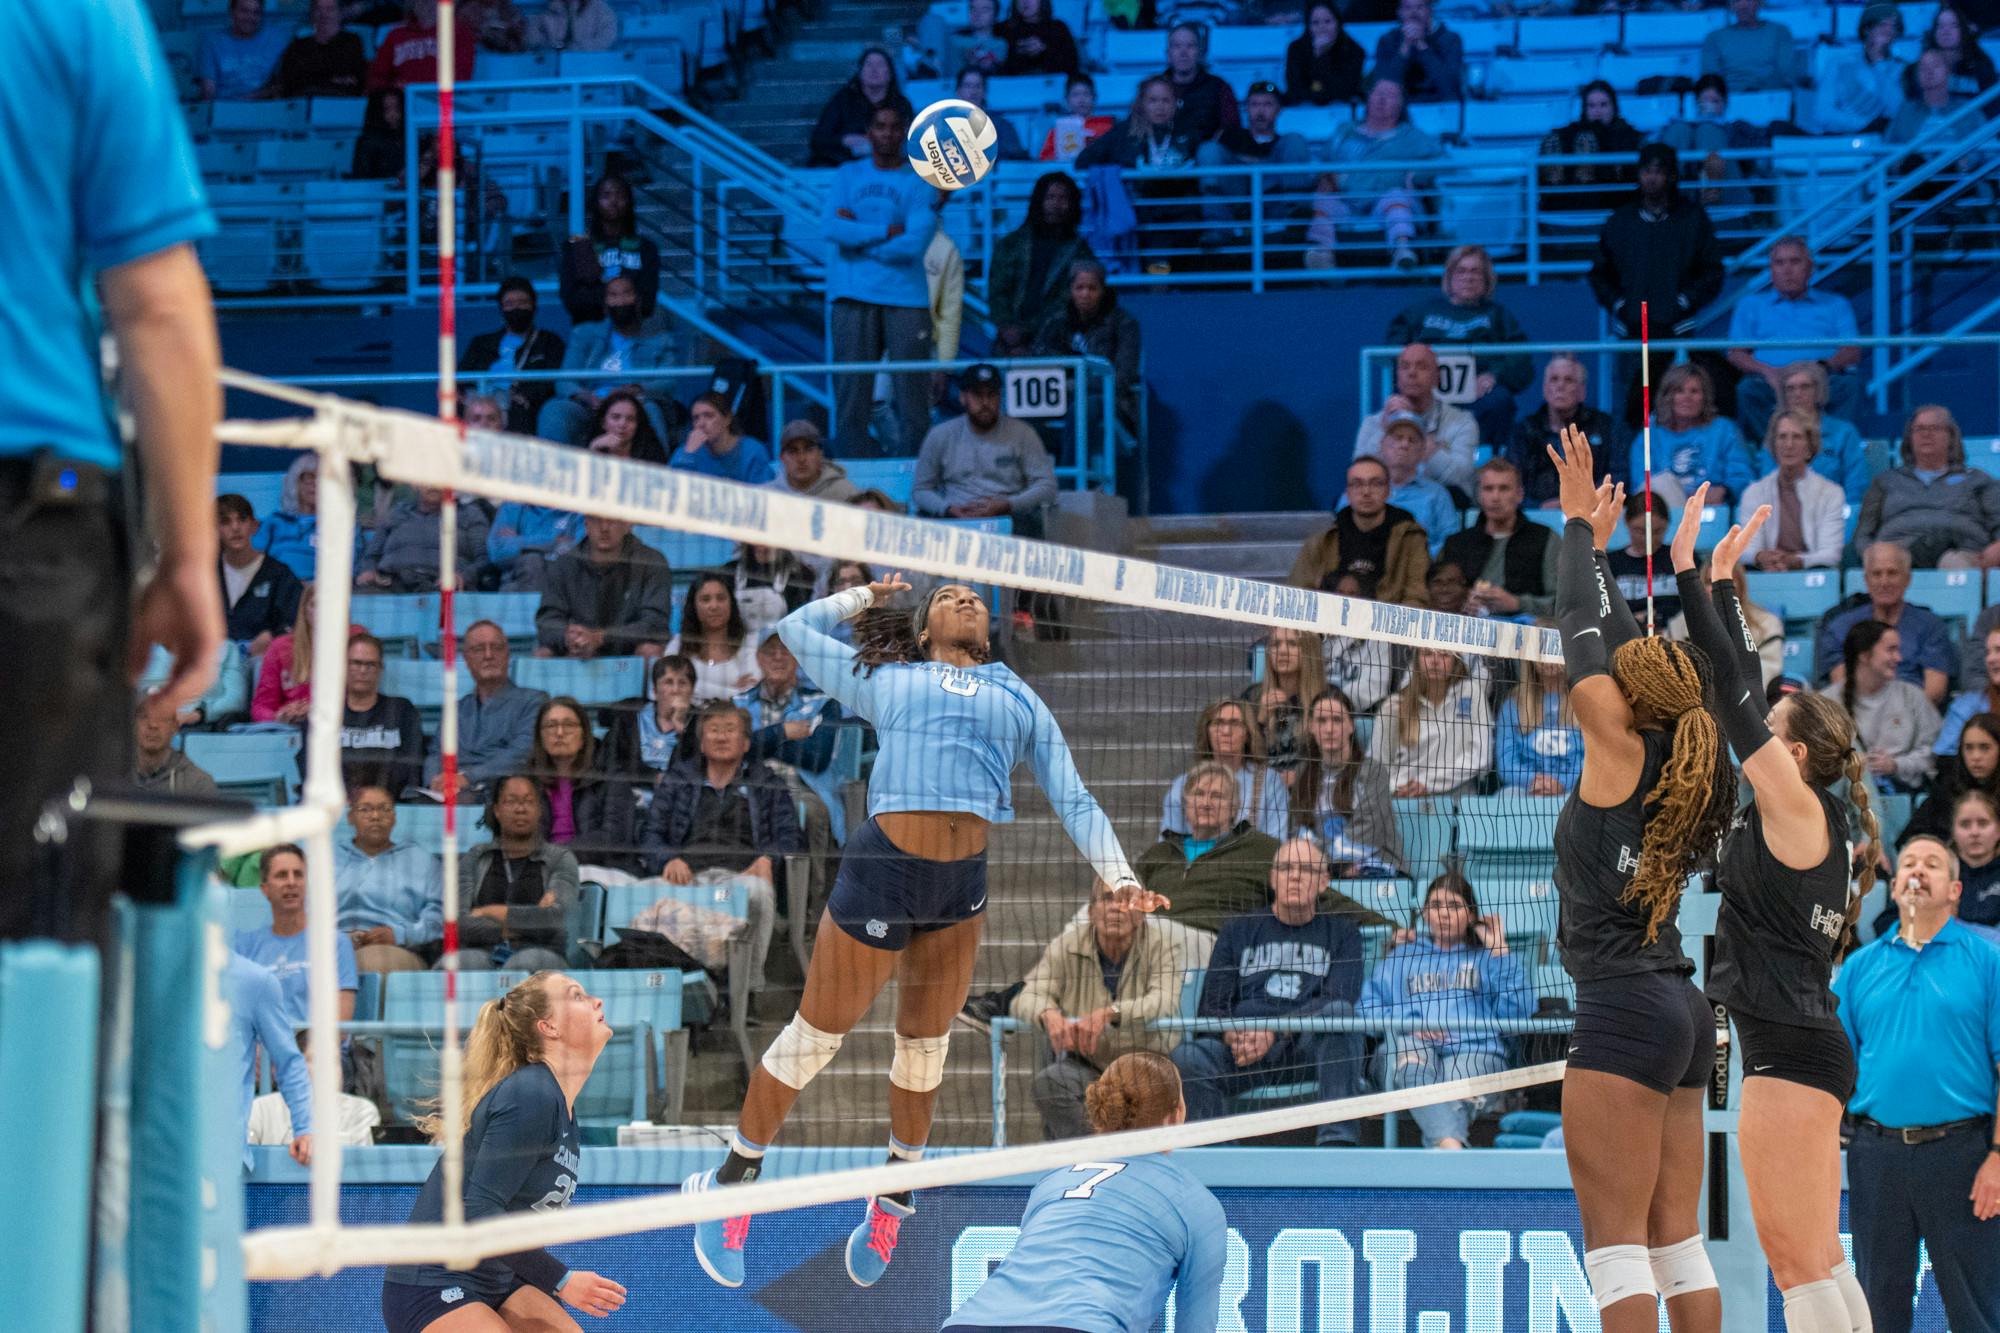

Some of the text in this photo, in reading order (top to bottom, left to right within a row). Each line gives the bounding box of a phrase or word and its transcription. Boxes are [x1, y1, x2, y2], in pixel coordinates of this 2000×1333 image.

[927, 140, 956, 184] molten
[1013, 377, 1059, 406] 106
[1438, 364, 1468, 393] 07
[1715, 1046, 1729, 1105] mports
[1062, 1160, 1129, 1200] 7
